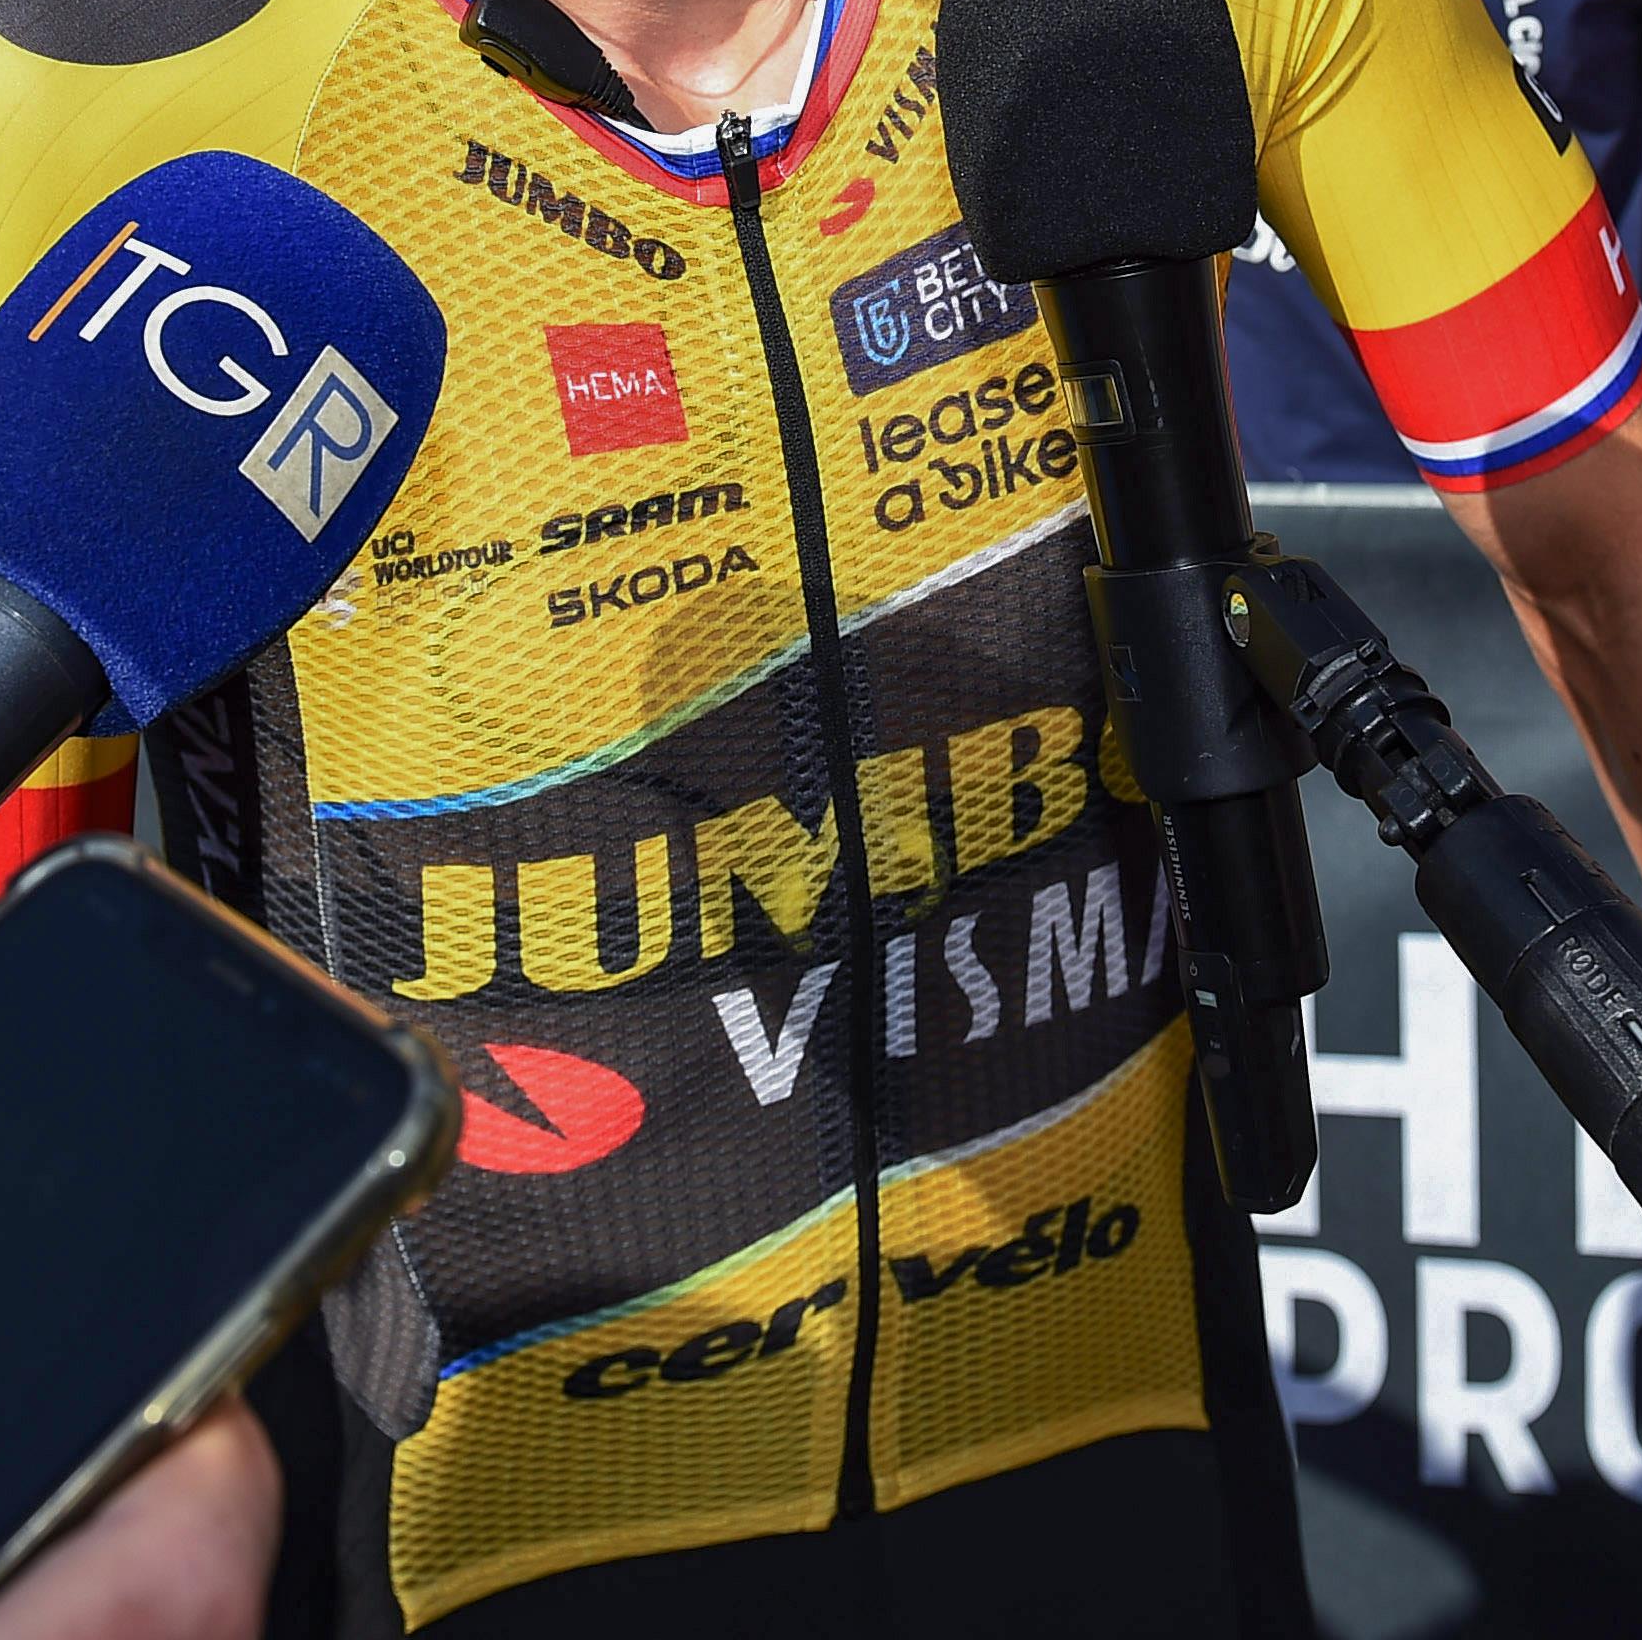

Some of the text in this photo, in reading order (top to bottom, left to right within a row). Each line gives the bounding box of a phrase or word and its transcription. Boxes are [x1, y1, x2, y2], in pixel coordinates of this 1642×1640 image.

[865, 45, 938, 165] VISM
[452, 138, 687, 282] JUMBO
[923, 278, 1011, 342] CITY
[566, 366, 667, 405] HEMA
[860, 360, 1057, 474] lease
[538, 480, 751, 556] SRAM
[875, 425, 1078, 533] a bike
[371, 529, 416, 560] UCI
[373, 539, 515, 587] WORLDTOUR
[1163, 813, 1192, 922] SENNHEISER
